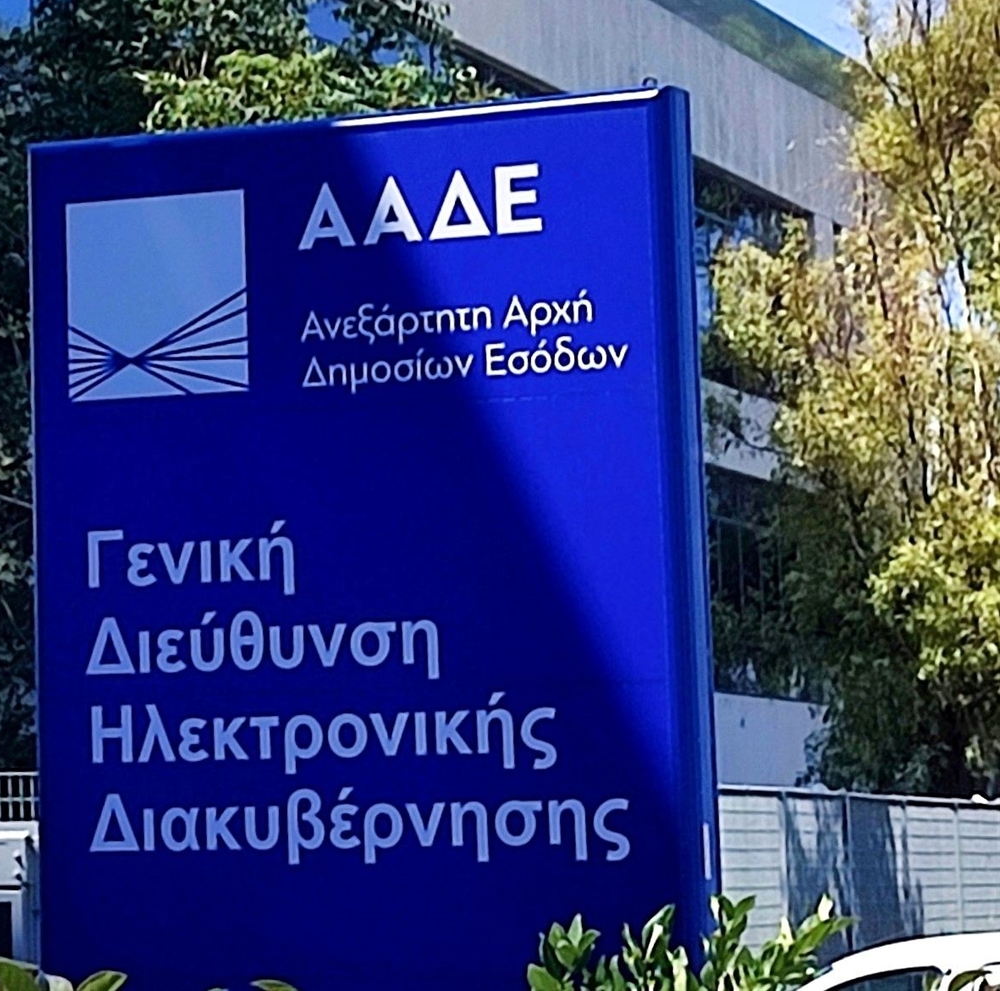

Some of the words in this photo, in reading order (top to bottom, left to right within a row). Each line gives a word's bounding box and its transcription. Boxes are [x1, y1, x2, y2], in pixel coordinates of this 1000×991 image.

[299, 163, 543, 250] ΑΑΔΕ
[301, 304, 492, 344] Ανεξάρτητη
[503, 289, 593, 336] Αρχή
[302, 348, 474, 394] Δημοσίων
[485, 336, 629, 376] Εσόδων
[87, 520, 295, 595] Γενική
[86, 610, 440, 679] Διεύθυνση
[91, 692, 557, 774] Ηλεκτρονικής
[90, 787, 630, 865] Διακυβέρνησης
